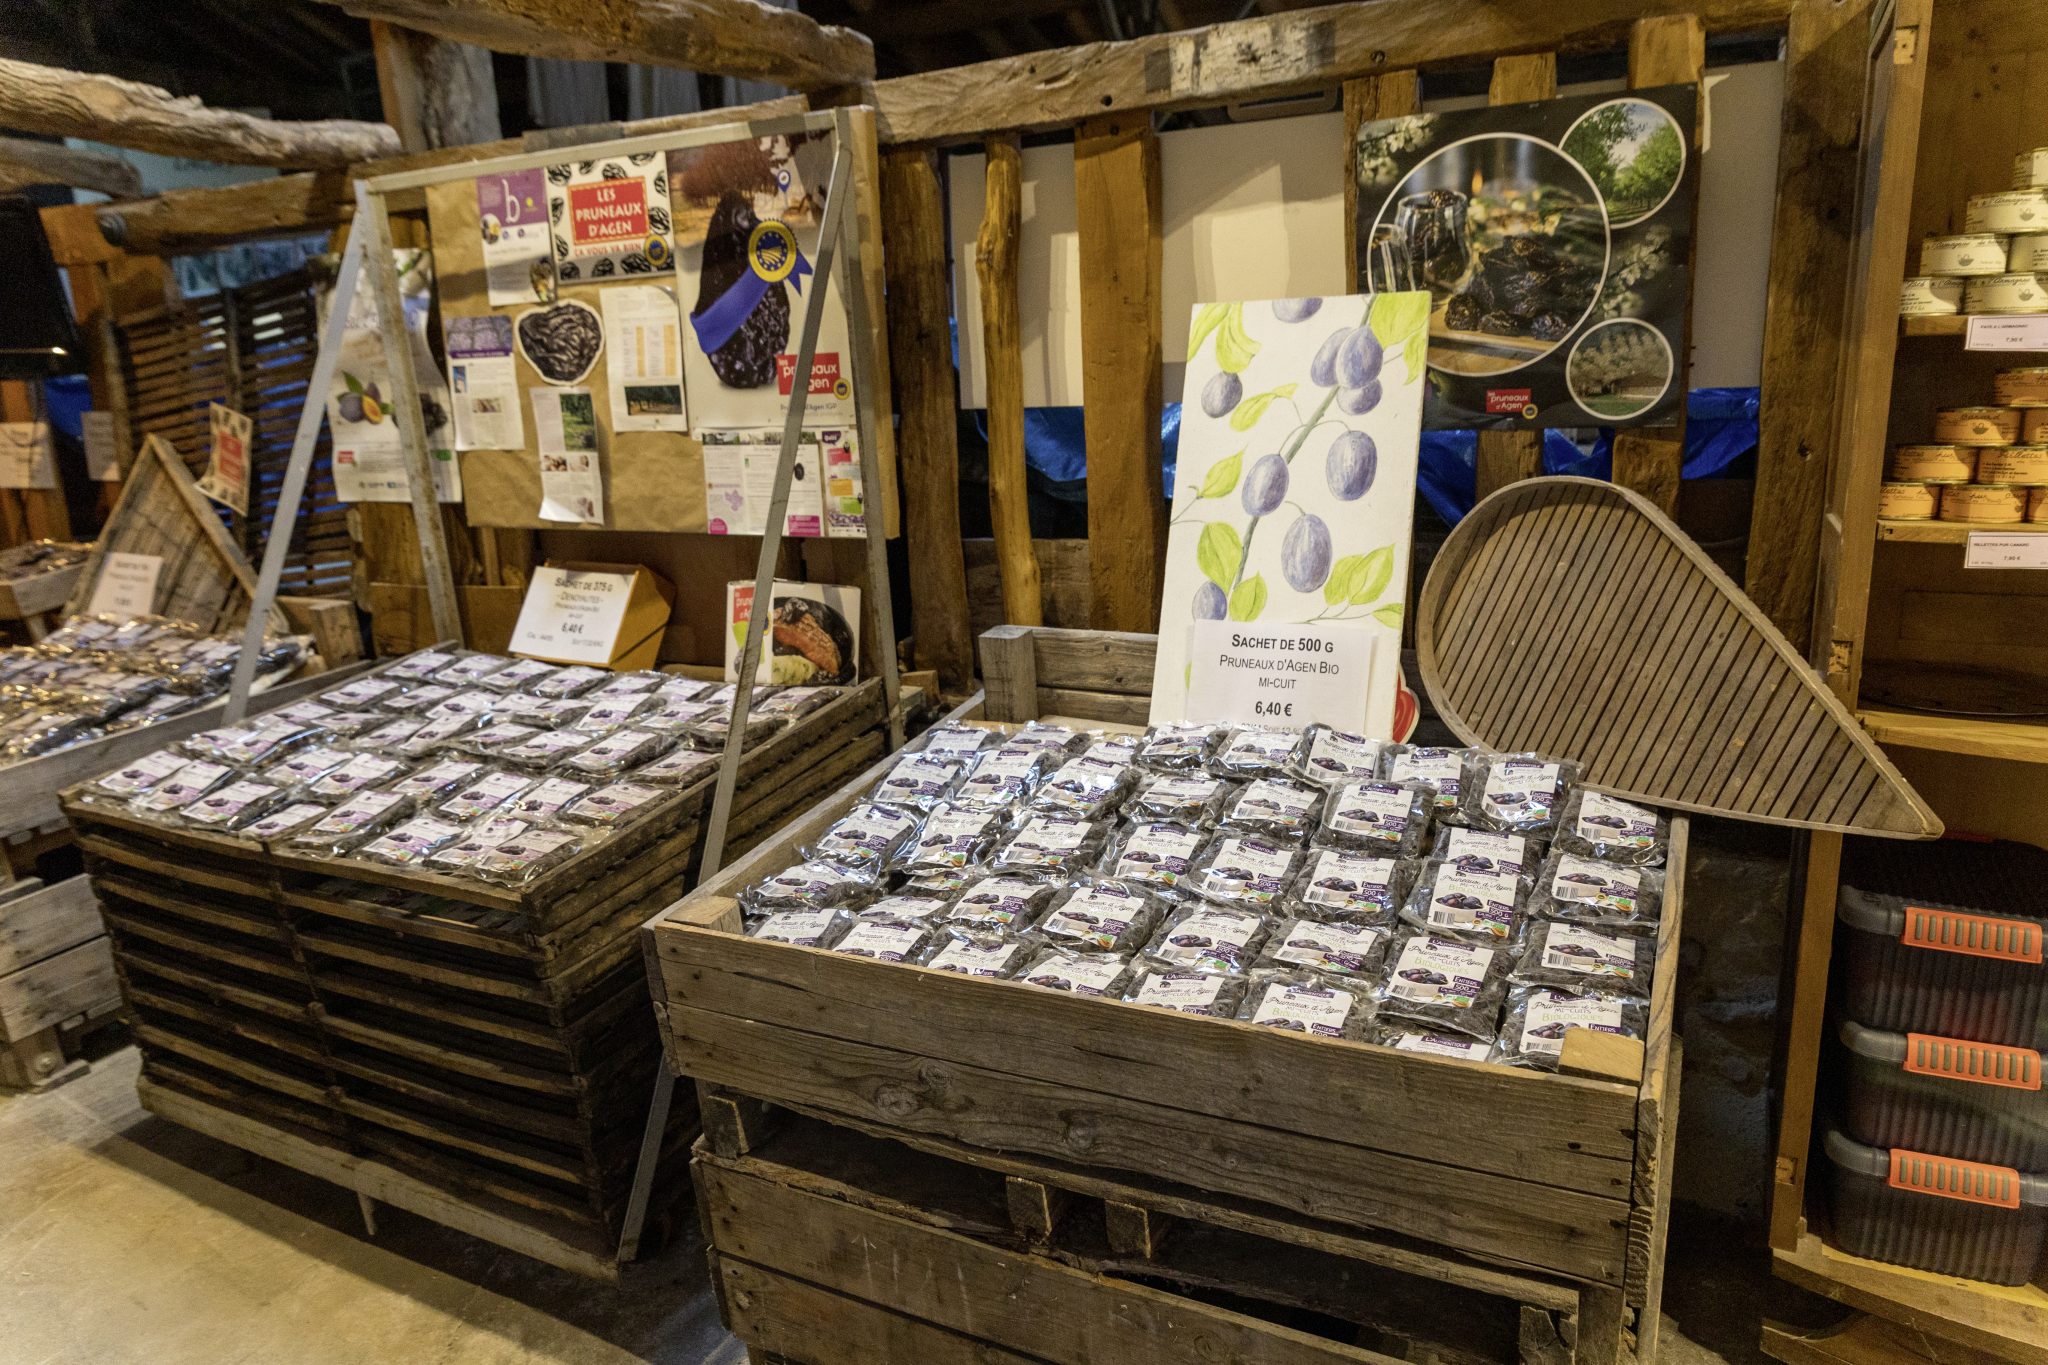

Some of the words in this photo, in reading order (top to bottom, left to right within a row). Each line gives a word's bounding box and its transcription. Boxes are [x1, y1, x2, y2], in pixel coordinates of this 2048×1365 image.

[596, 188, 616, 203] LES
[575, 202, 643, 222] PRUNEAUX
[588, 221, 633, 237] D'AGEN
[1491, 395, 1529, 404] pruneaux
[1232, 634, 1277, 649] SACHET
[1280, 638, 1295, 650] DE
[1298, 638, 1321, 651] 500
[1325, 641, 1334, 653] G
[1220, 655, 1275, 669] PRUNEAUX
[1277, 658, 1316, 672] D'AGEN
[1319, 661, 1339, 675] BIO
[1258, 677, 1297, 690] MI-CUIT
[1255, 700, 1281, 717] 6,40
[1284, 702, 1293, 717] €
[1460, 866, 1497, 877] L'AUTHENTIQUE
[1440, 875, 1480, 886] Pruneaux
[1482, 881, 1513, 892] d'Agen
[1488, 900, 1510, 911] ENTIERS
[1490, 908, 1503, 917] 500
[1432, 938, 1473, 951] L'AUTHENTIQUE
[1408, 945, 1451, 960] Pruneaux
[1453, 954, 1485, 967] d'Agen
[1454, 976, 1478, 987] ENTIERS
[1455, 983, 1469, 992] 500
[1143, 987, 1184, 995] Pruneaux
[1266, 996, 1308, 1009] Pruneaux
[1311, 1003, 1344, 1015] d'Agen
[1532, 1001, 1579, 1010] Pruneaux
[1581, 1004, 1619, 1014] d'Agen
[1542, 1013, 1601, 1022] BIOLOGIQUES
[1312, 1023, 1337, 1033] ENTIERS
[1590, 1024, 1617, 1033] ENTIERS
[1425, 1036, 1468, 1049] L'AUTHENTIQUE
